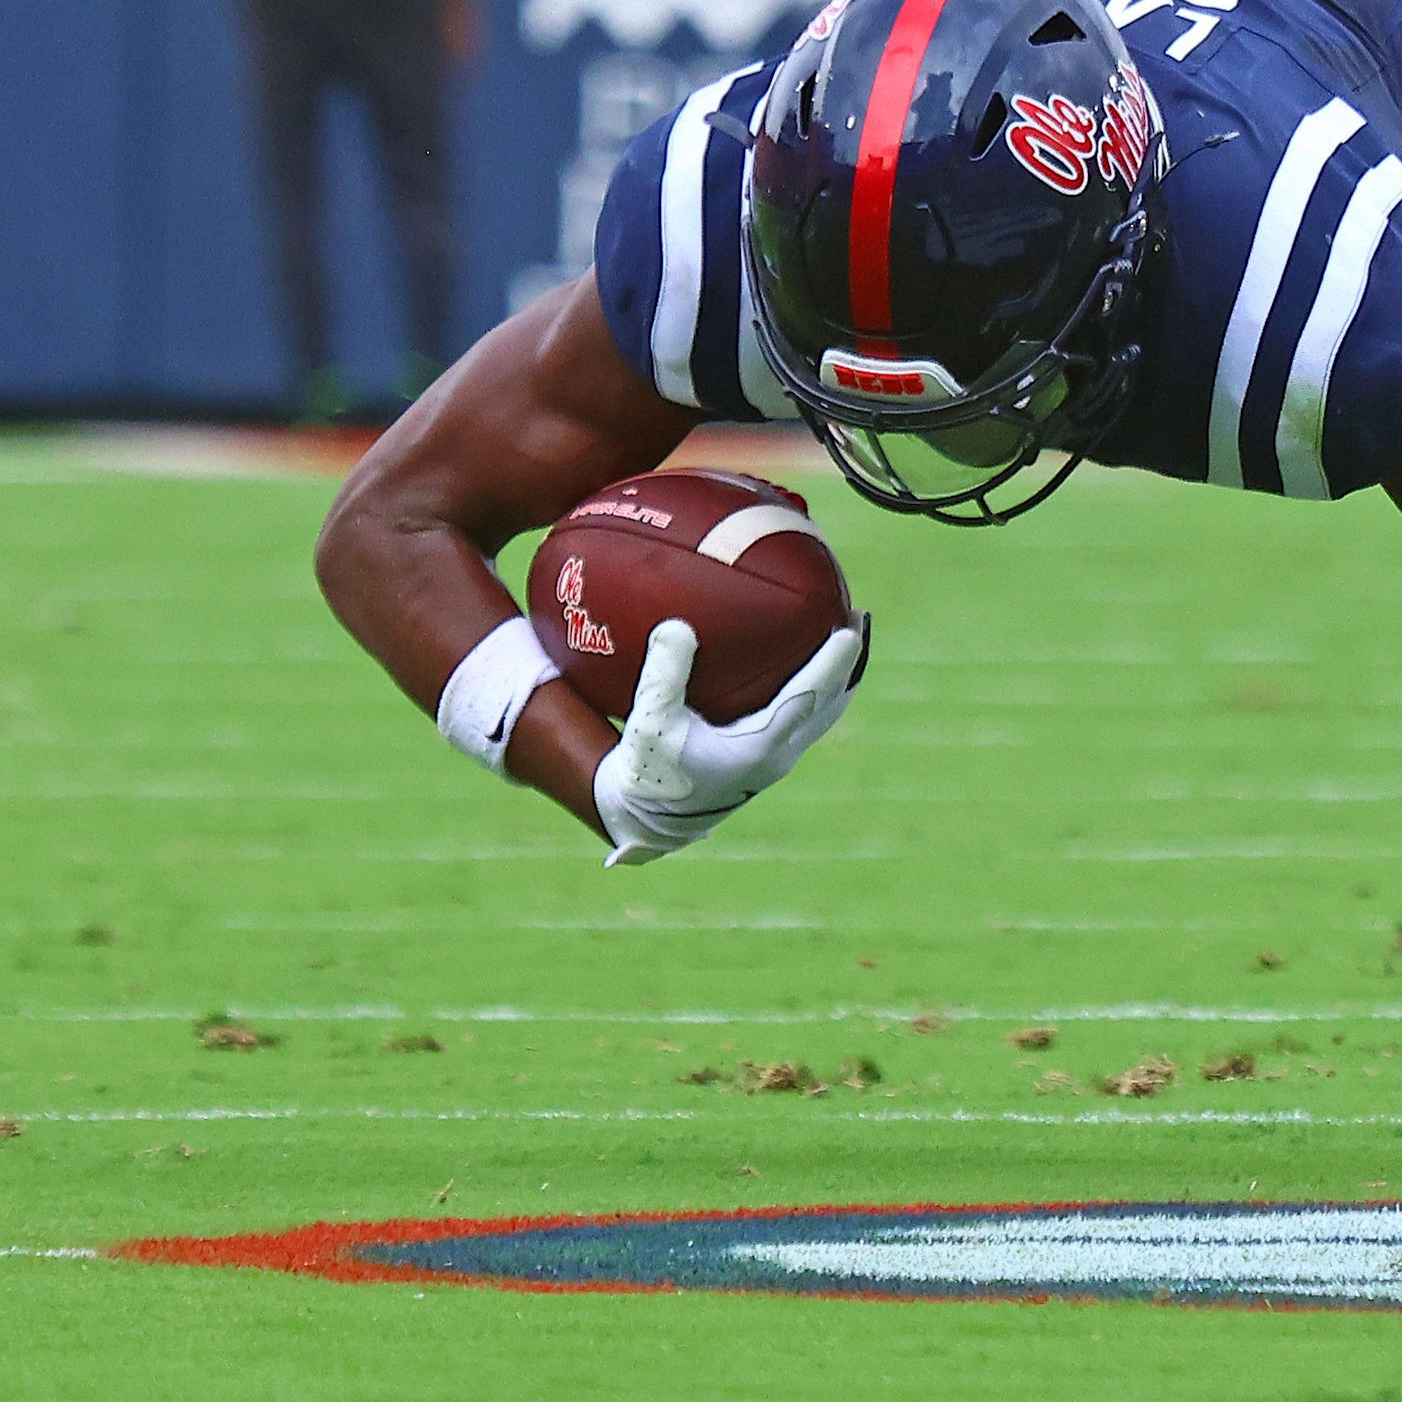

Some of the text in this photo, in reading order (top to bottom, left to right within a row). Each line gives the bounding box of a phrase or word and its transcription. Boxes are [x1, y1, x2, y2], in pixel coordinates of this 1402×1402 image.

[1005, 94, 1097, 196] Ole
[556, 556, 584, 607] Ole
[564, 605, 615, 656] Miss
